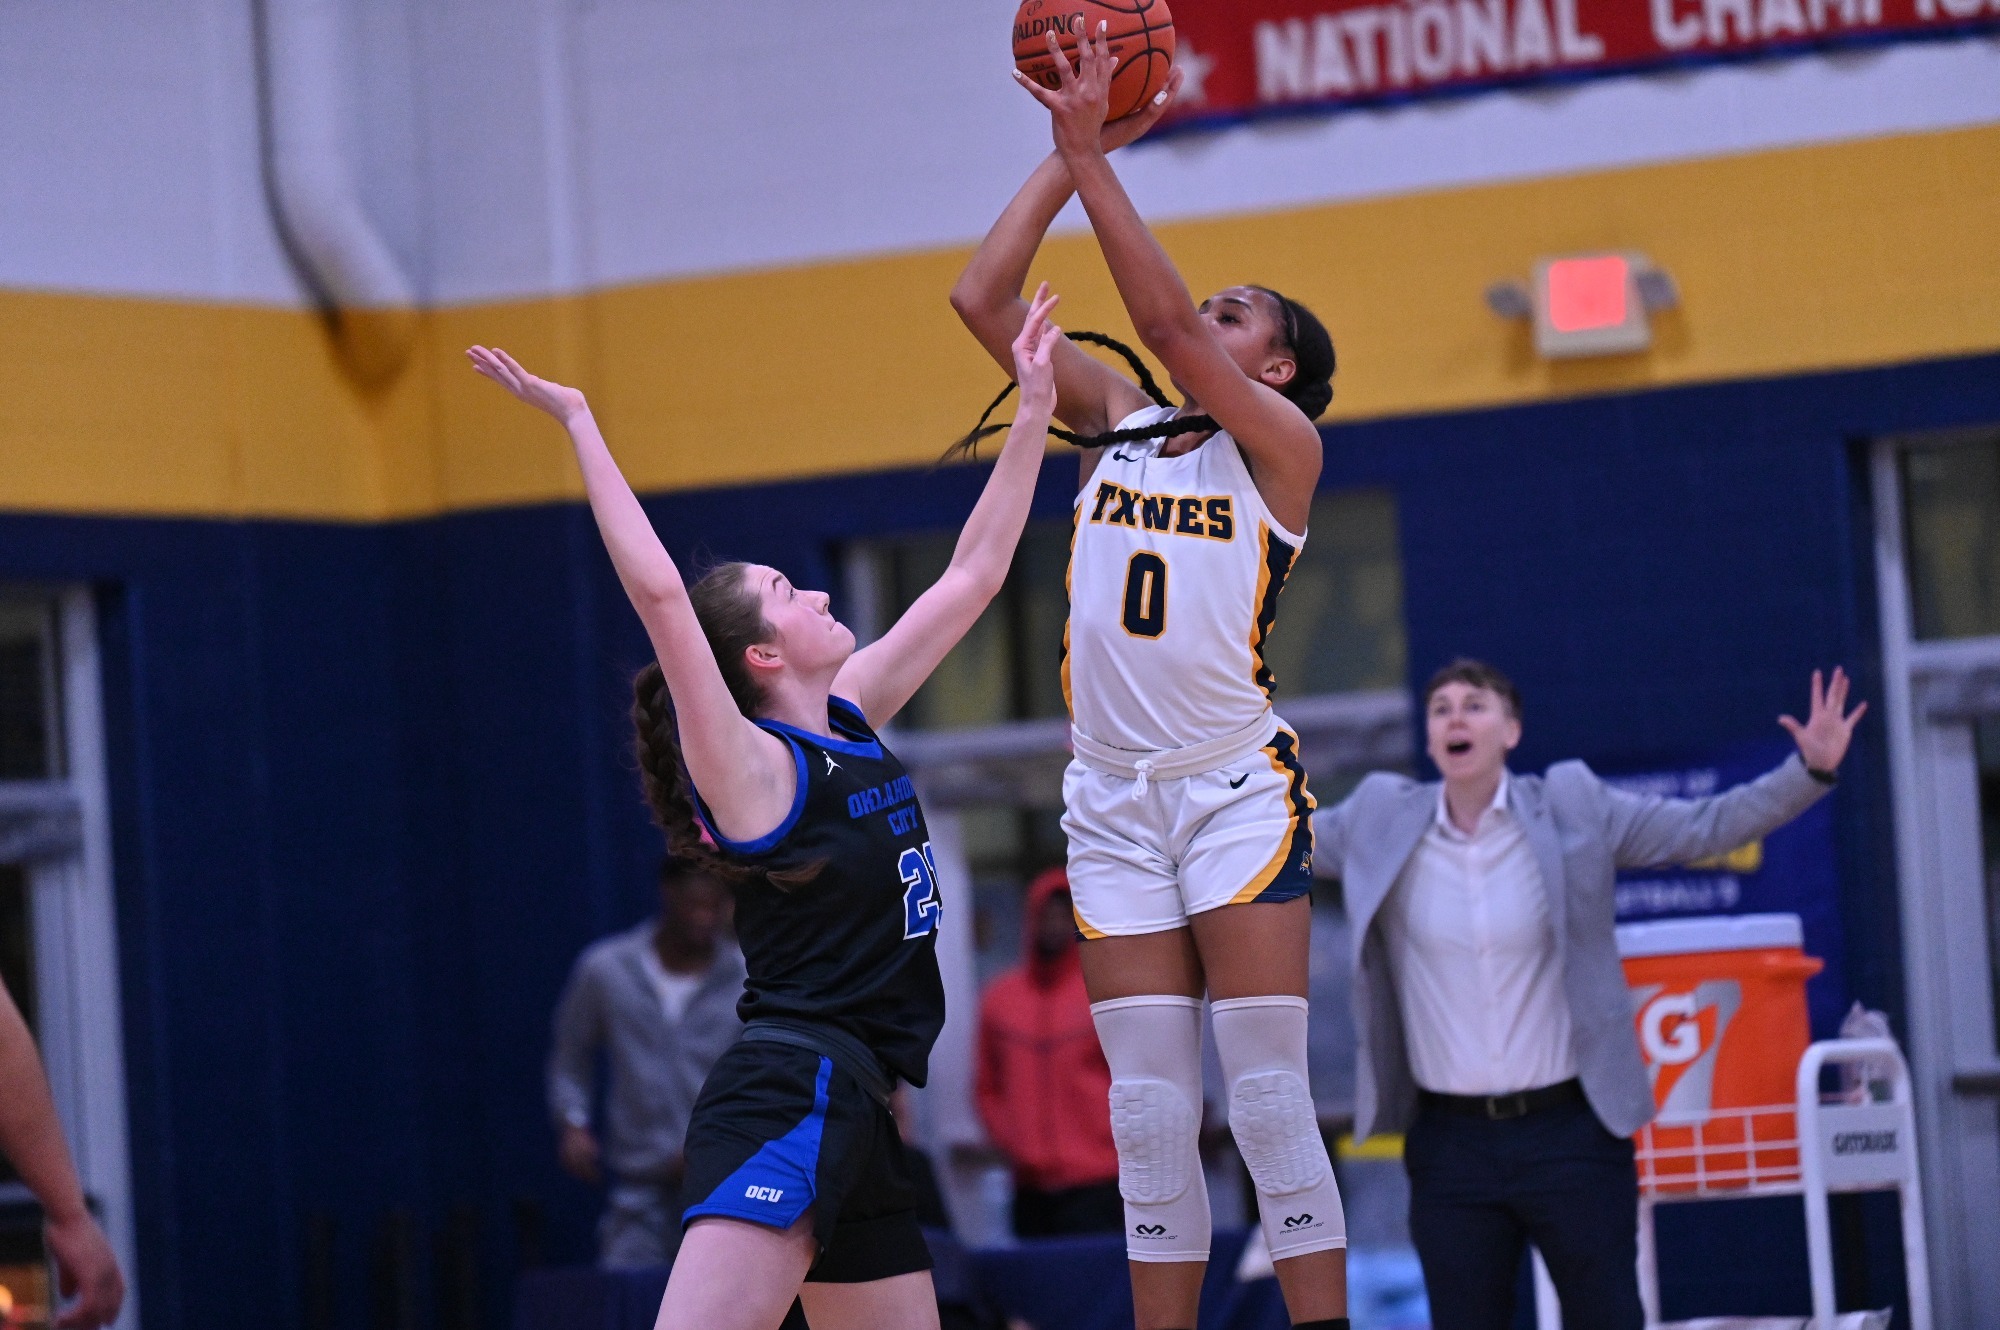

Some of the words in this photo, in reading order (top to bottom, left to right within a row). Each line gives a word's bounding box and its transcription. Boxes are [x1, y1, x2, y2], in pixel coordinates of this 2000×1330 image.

[1255, 0, 1605, 100] NATIONAL
[1120, 549, 1169, 640] 0
[847, 774, 917, 819] OKLAHO
[887, 803, 918, 836] CITY
[898, 841, 943, 940] 2
[1641, 995, 1701, 1063] G
[745, 1185, 783, 1203] OCU
